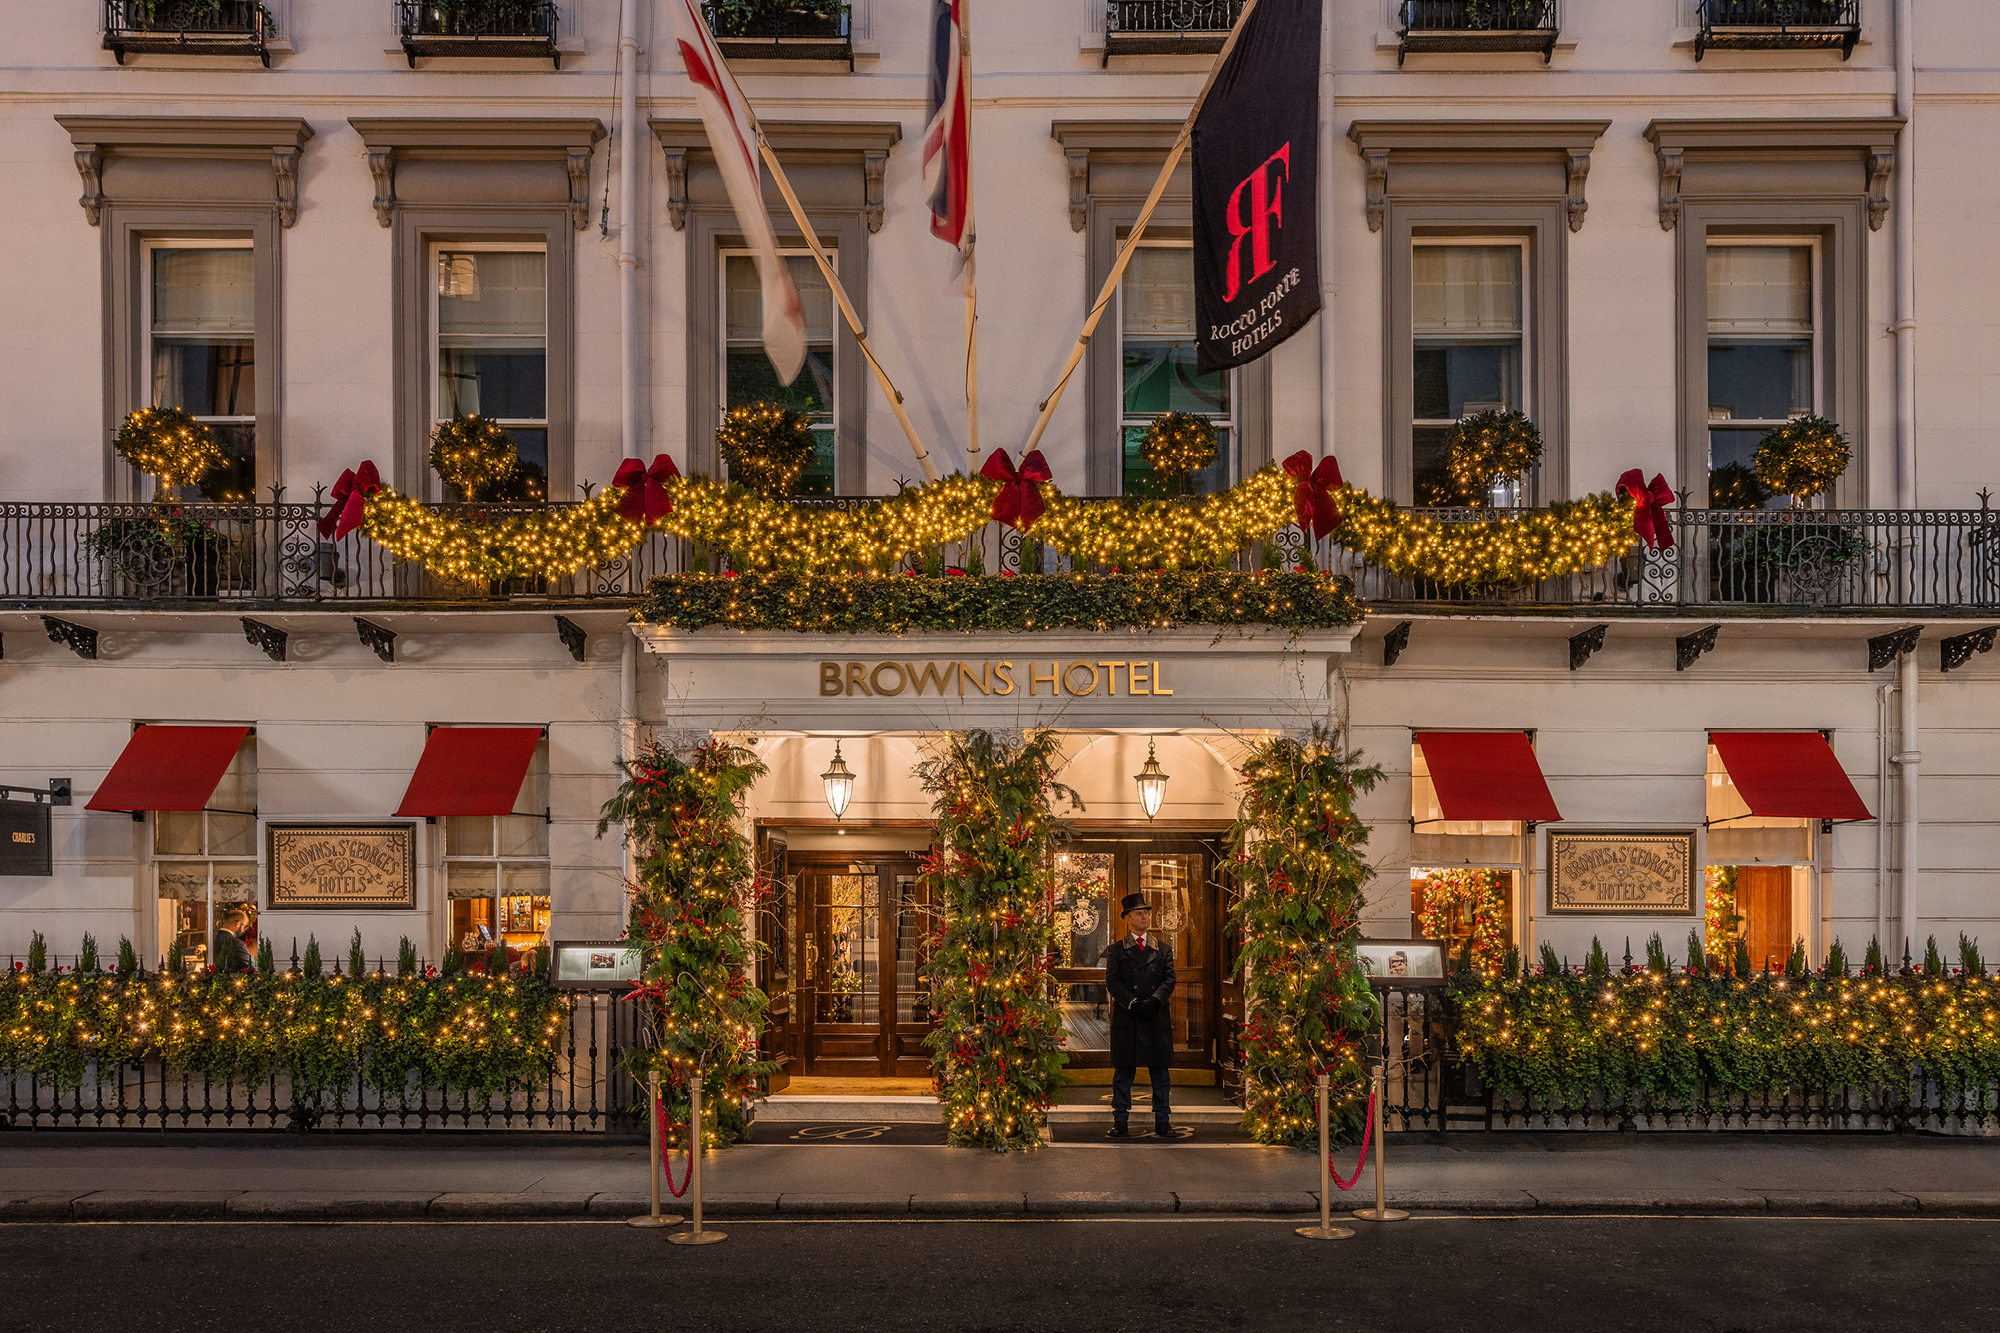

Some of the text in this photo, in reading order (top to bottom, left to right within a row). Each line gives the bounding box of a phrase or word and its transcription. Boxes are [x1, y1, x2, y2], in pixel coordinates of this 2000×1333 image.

[1210, 267, 1300, 341] ROCCO FORTE
[1231, 309, 1282, 357] HOTELS
[819, 660, 1174, 697] BROWNS HOTEL
[317, 876, 367, 894] HOTELS
[1596, 882, 1647, 901] HOTELS
